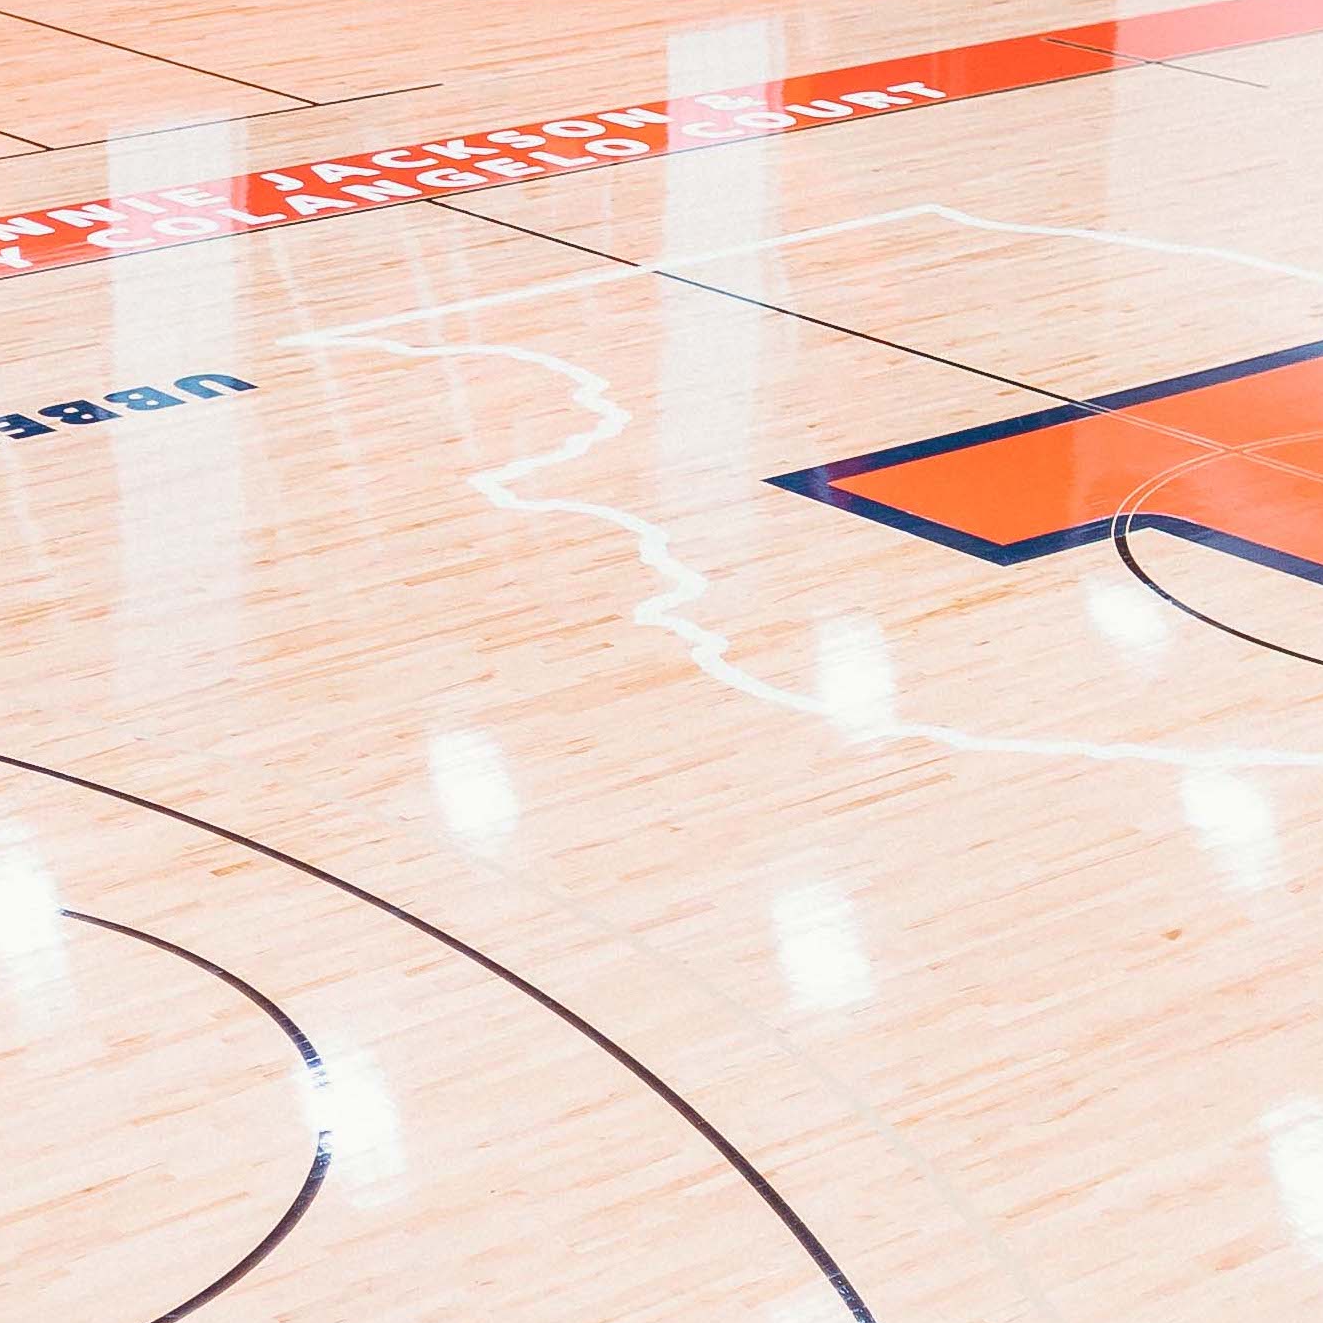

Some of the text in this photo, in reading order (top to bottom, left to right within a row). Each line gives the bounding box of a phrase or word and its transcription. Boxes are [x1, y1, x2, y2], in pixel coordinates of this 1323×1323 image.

[84, 135, 652, 251] COLANGELO
[680, 80, 948, 141] COURT
[260, 104, 676, 193] JACKSON
[694, 91, 769, 113] &
